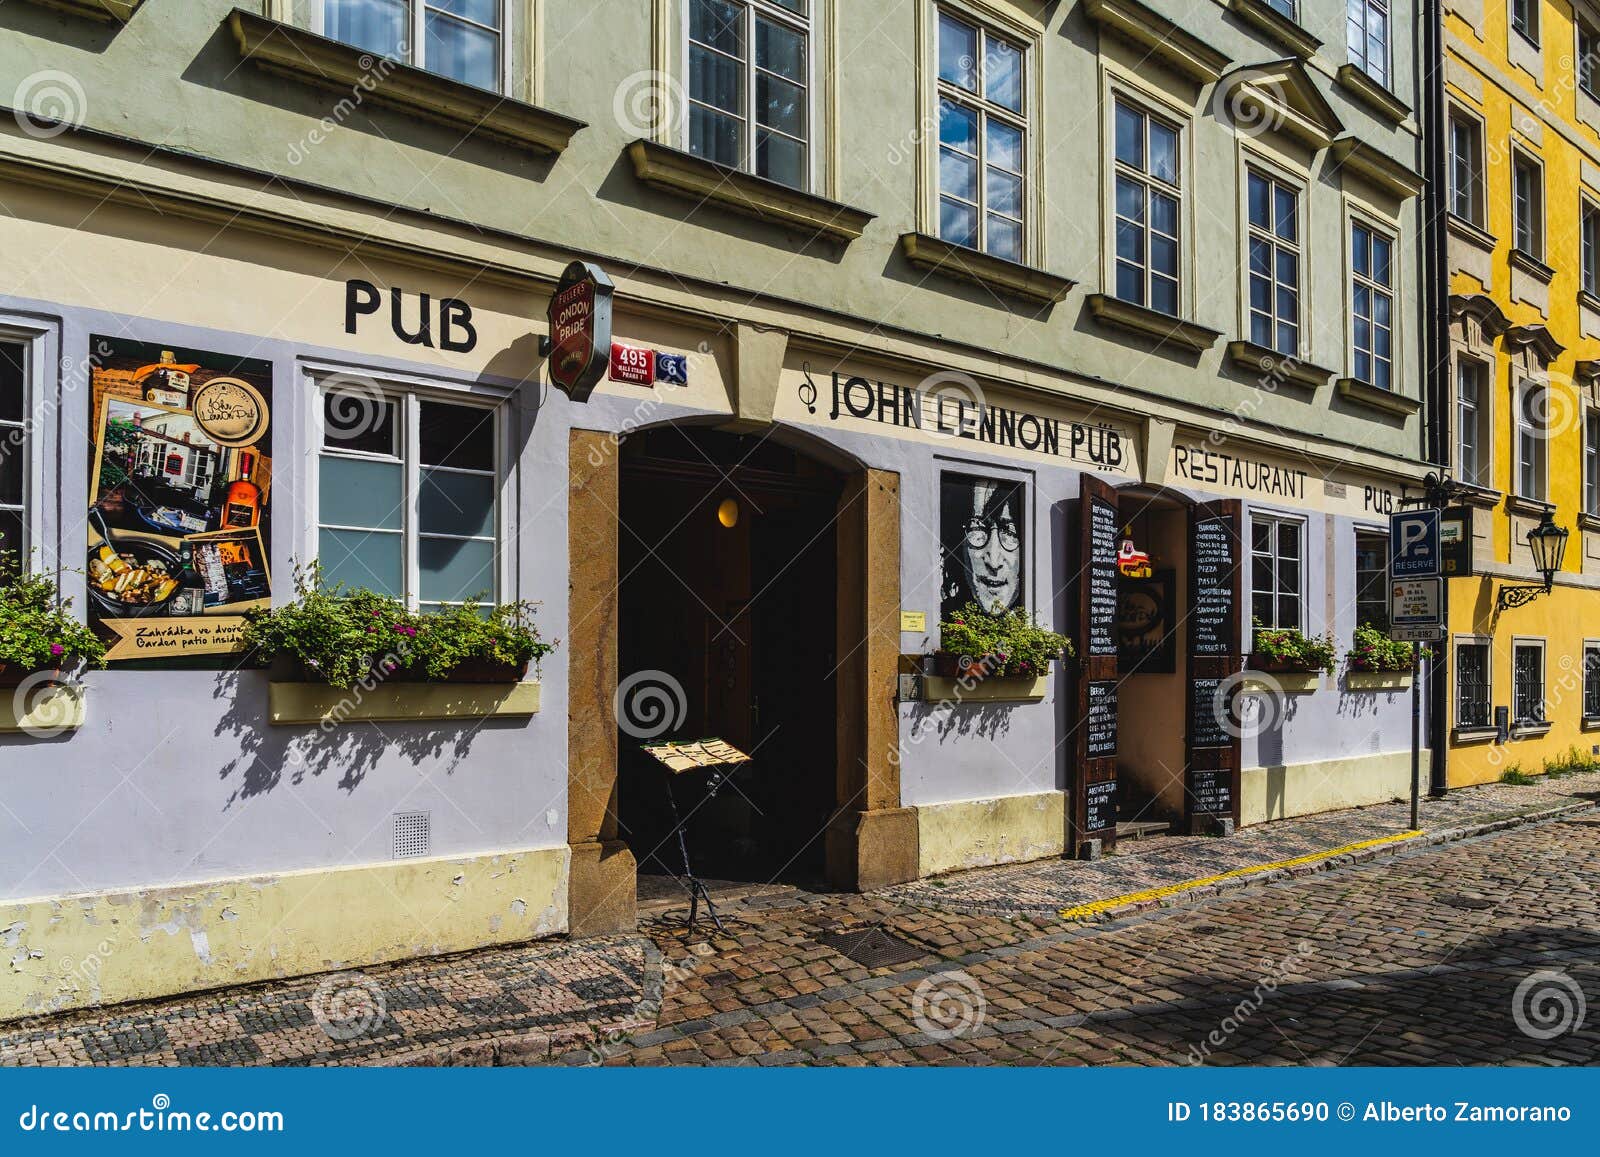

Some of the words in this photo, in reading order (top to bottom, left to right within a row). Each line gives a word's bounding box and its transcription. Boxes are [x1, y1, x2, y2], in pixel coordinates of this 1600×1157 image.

[345, 279, 477, 353] PUB
[555, 301, 590, 330] LONDON
[560, 318, 585, 342] PRIDE
[620, 349, 647, 368] 495
[667, 360, 677, 376] 6
[830, 372, 922, 430] JOHN
[937, 394, 1059, 455] LENNON
[1071, 422, 1122, 466] PUB
[1174, 445, 1307, 500] RESTAURANT
[1364, 485, 1393, 516] PUB
[1401, 519, 1428, 557] P
[1197, 565, 1218, 573] PIZZA
[1197, 577, 1218, 585] PASTA
[136, 636, 177, 648] Garden
[182, 637, 208, 648] patio
